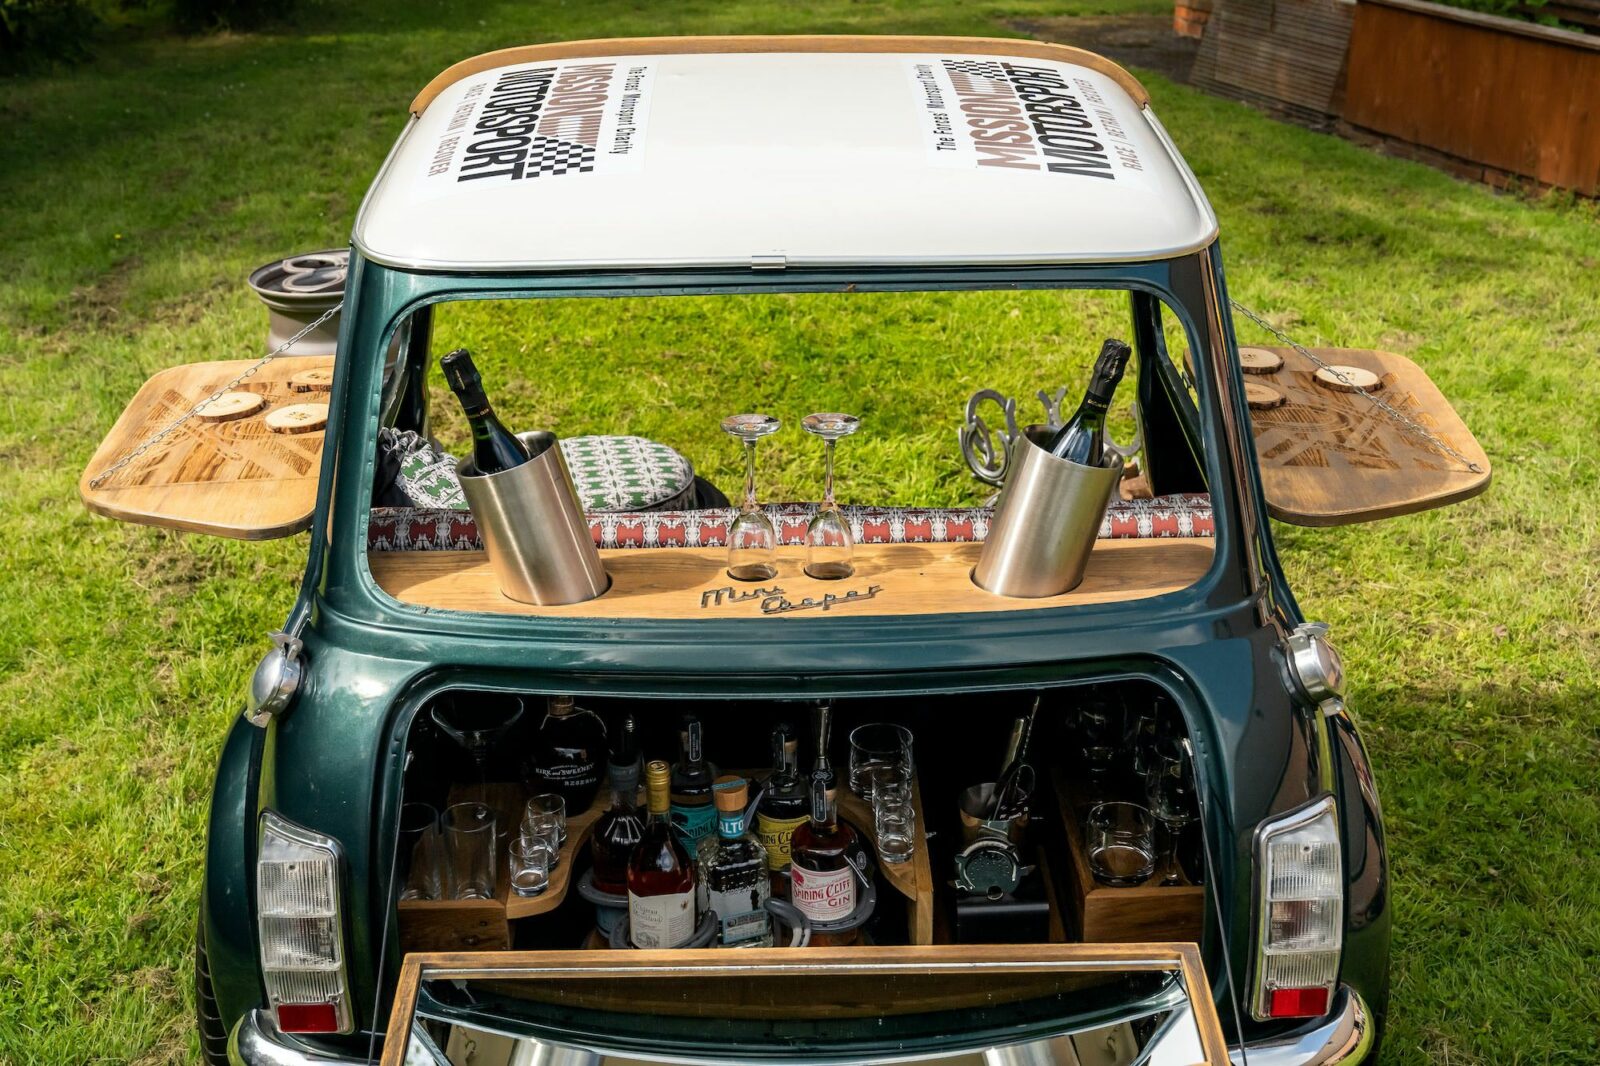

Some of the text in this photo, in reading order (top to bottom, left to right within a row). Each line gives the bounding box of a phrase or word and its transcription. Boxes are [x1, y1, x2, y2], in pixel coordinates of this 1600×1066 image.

[913, 64, 934, 79] Charity
[542, 63, 616, 118] MISSION
[925, 80, 946, 109] Motorsport
[615, 93, 641, 126] Motorsport
[1000, 62, 1115, 180] MOTORSPORT
[428, 83, 487, 176] RACE RETRAIN RECOVER
[457, 67, 557, 182] MOTORSPORT
[957, 92, 1040, 170] MISSION
[1073, 78, 1143, 171] RACE RETRAIN RECOVER
[608, 127, 636, 154] Charity
[936, 137, 957, 151] The
[700, 585, 786, 608] Mini
[760, 585, 882, 614] Cooper
[535, 767, 551, 777] KIRK
[828, 894, 850, 907] GIN
